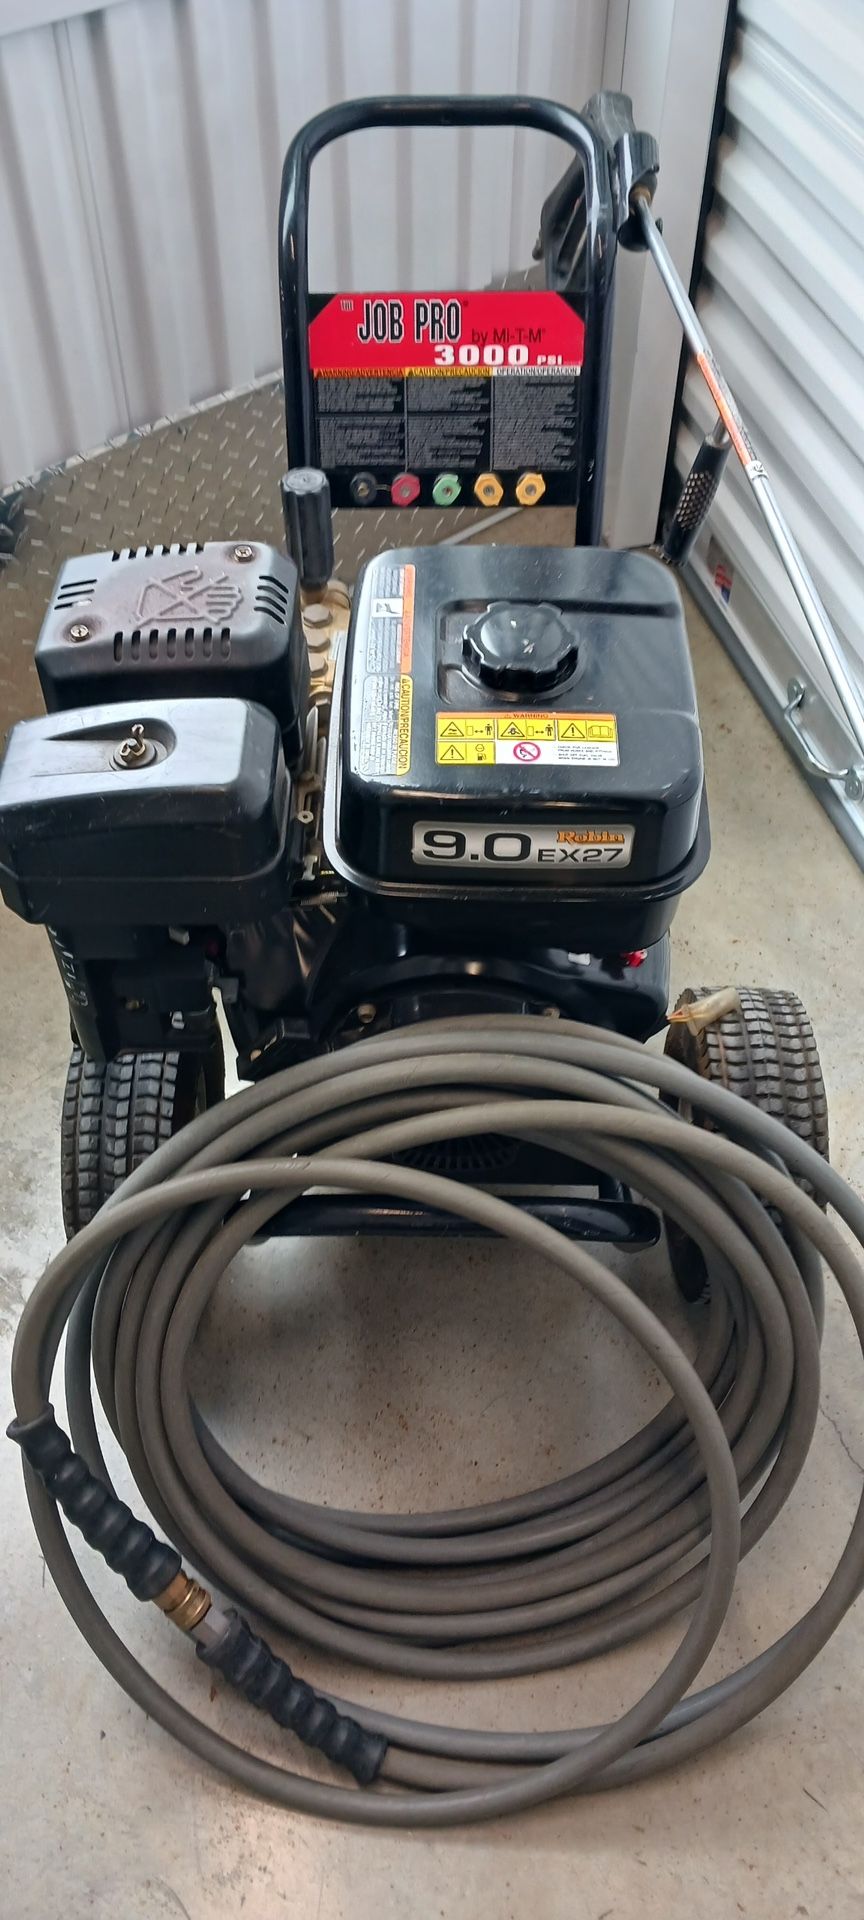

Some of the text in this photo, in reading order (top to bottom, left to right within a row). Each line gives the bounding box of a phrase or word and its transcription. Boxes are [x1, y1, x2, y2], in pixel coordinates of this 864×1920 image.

[357, 298, 462, 344] JOB PRO
[471, 327, 489, 346] by
[434, 344, 529, 366] 3000
[422, 829, 624, 863] 9.0 EX27
[556, 829, 625, 845] Robin
